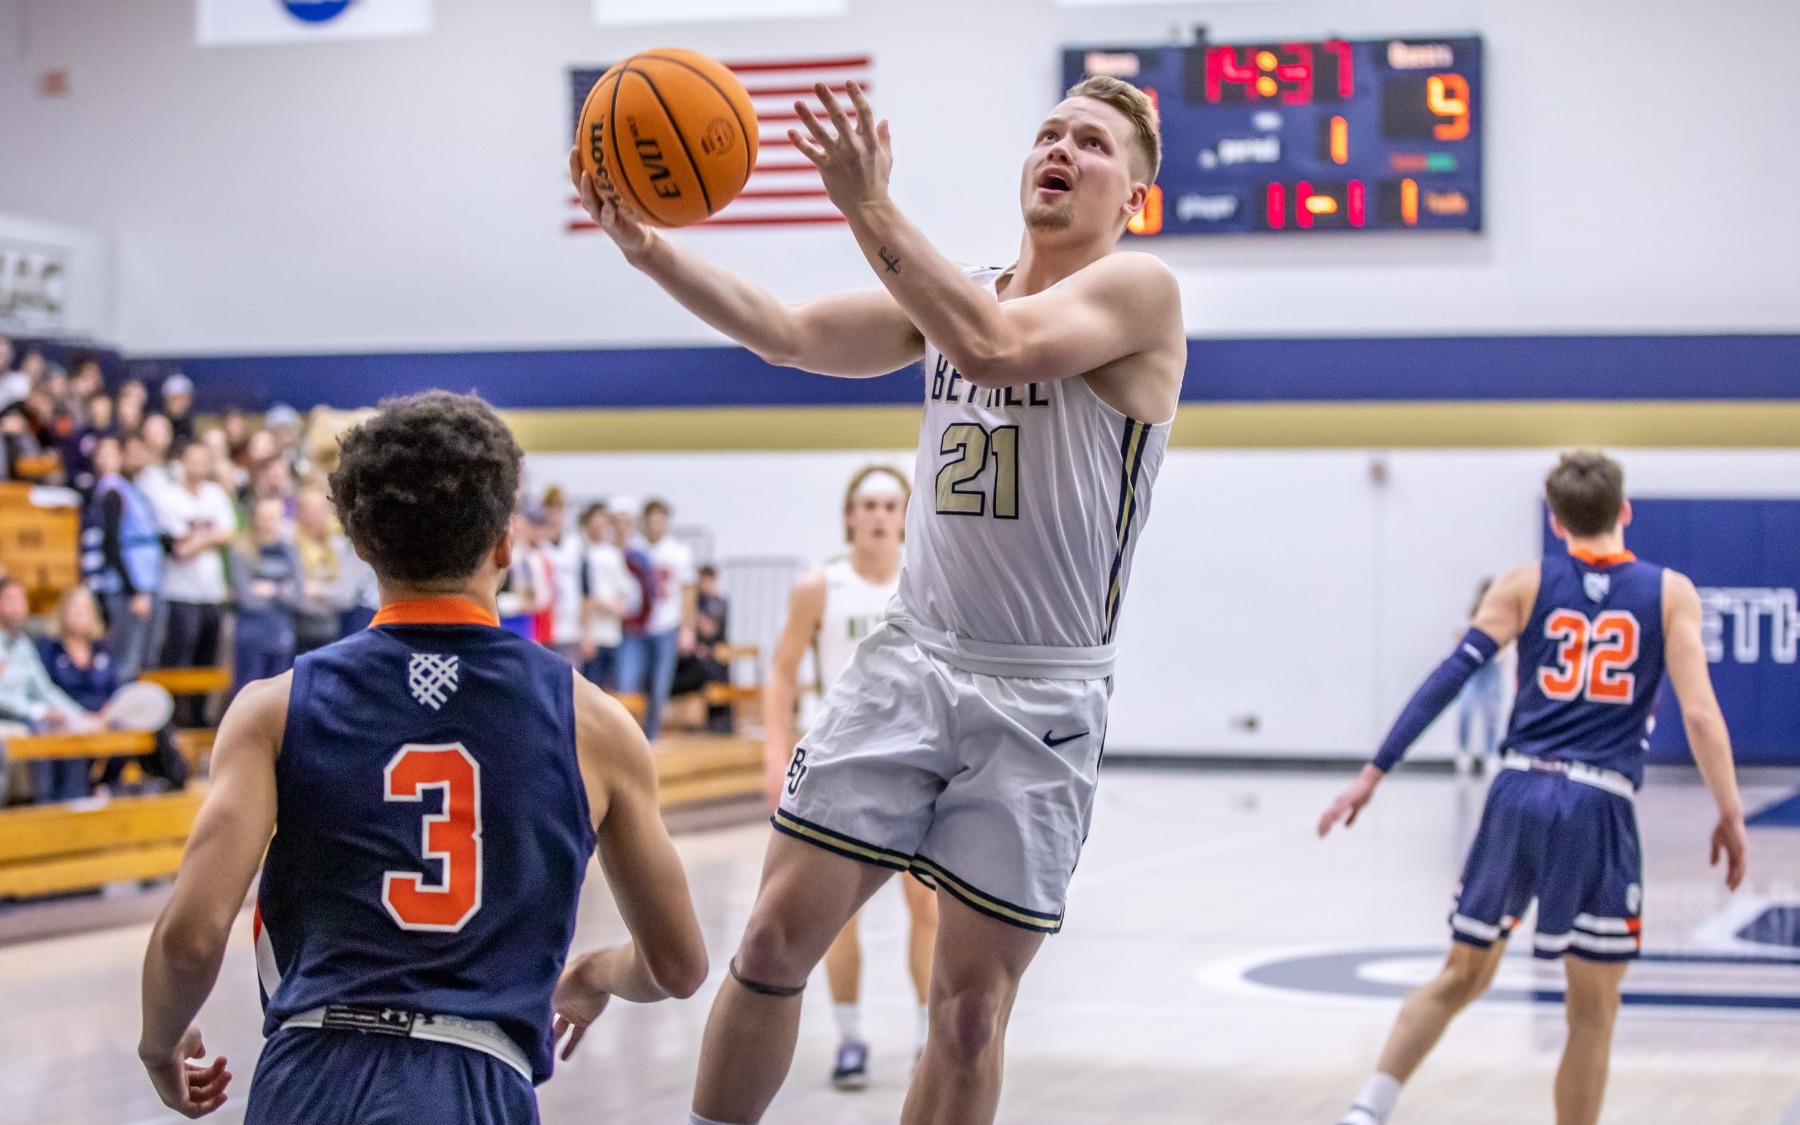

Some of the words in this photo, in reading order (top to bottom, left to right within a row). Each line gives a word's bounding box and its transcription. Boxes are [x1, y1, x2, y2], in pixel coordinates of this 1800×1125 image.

[1206, 40, 1353, 104] 14:37
[1427, 73, 1470, 140] 9
[1330, 115, 1349, 164] 1
[1401, 177, 1419, 226] 1
[935, 422, 1019, 520] 21
[1537, 608, 1641, 705] 32
[786, 747, 808, 795] BU
[381, 742, 483, 933] 3
